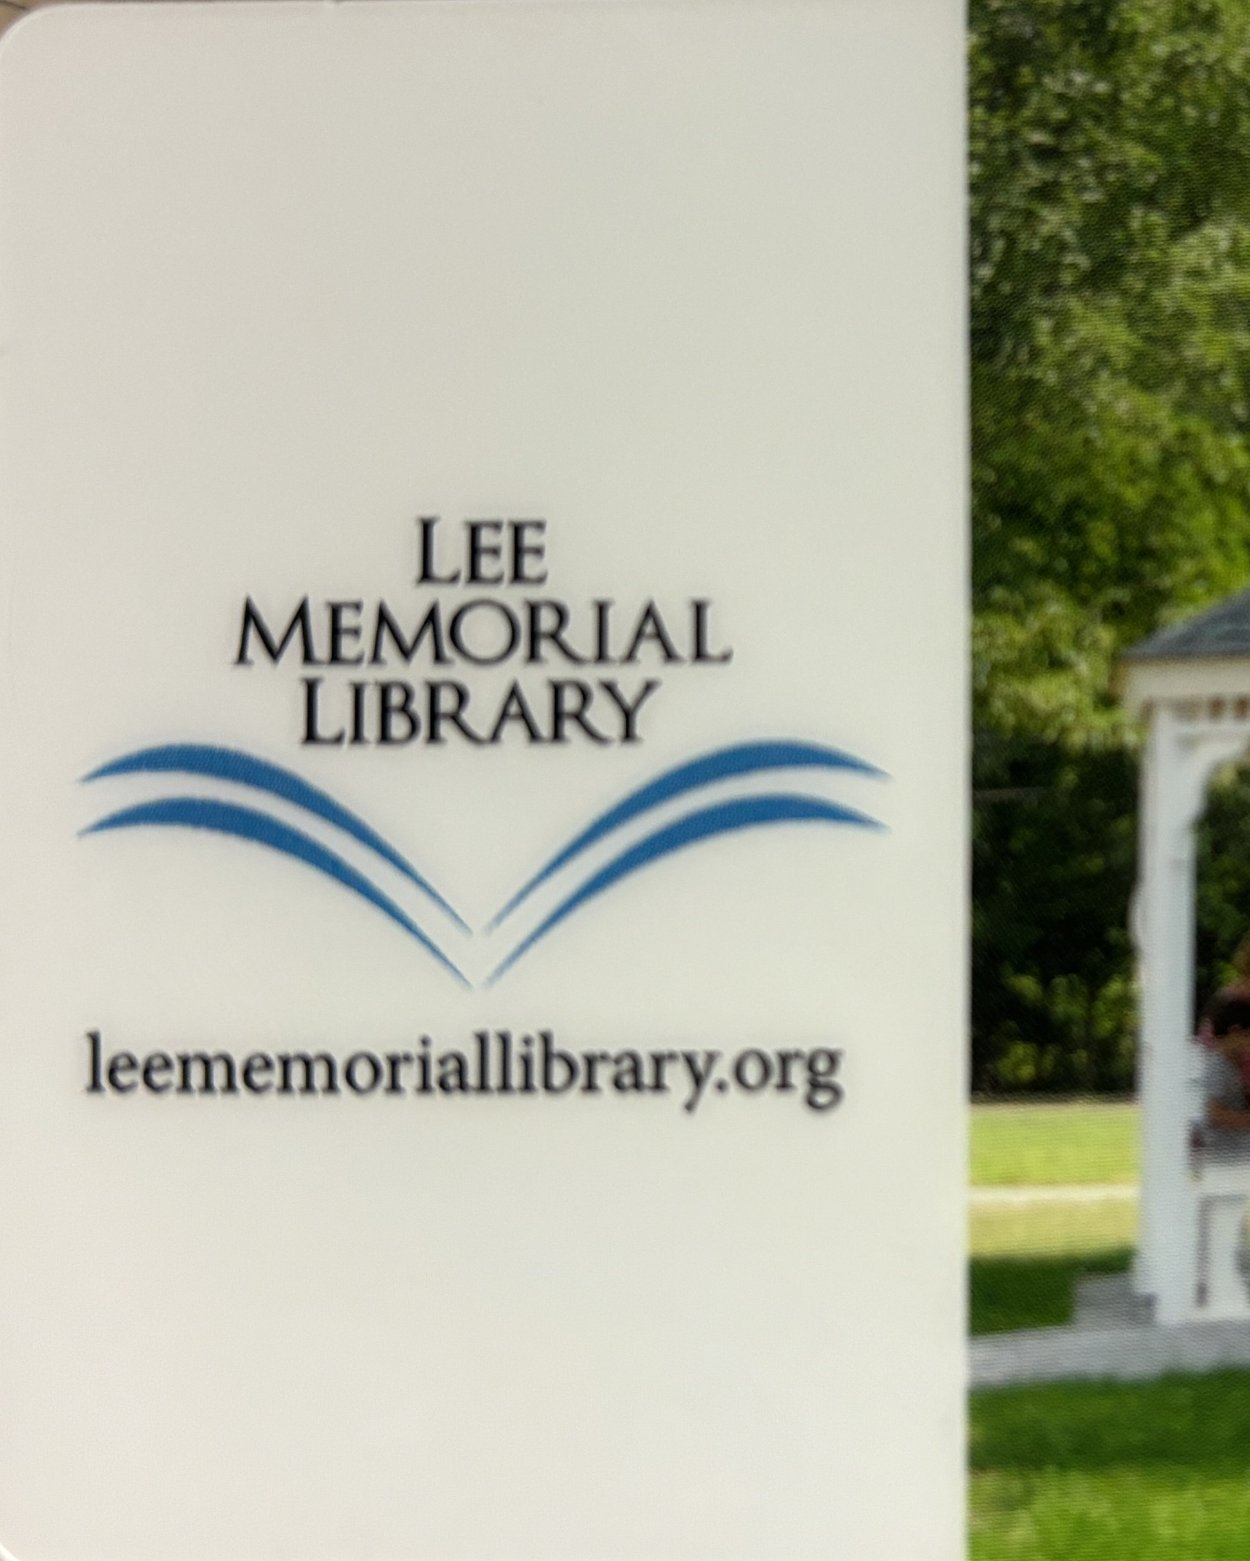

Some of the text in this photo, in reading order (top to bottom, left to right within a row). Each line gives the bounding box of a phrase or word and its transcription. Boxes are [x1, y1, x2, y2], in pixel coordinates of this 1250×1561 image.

[416, 516, 549, 587] LEE
[233, 596, 734, 668] MEMORIAL
[300, 676, 661, 748] LIBRARY
[85, 1030, 844, 1114] leememoriallibrary.org
